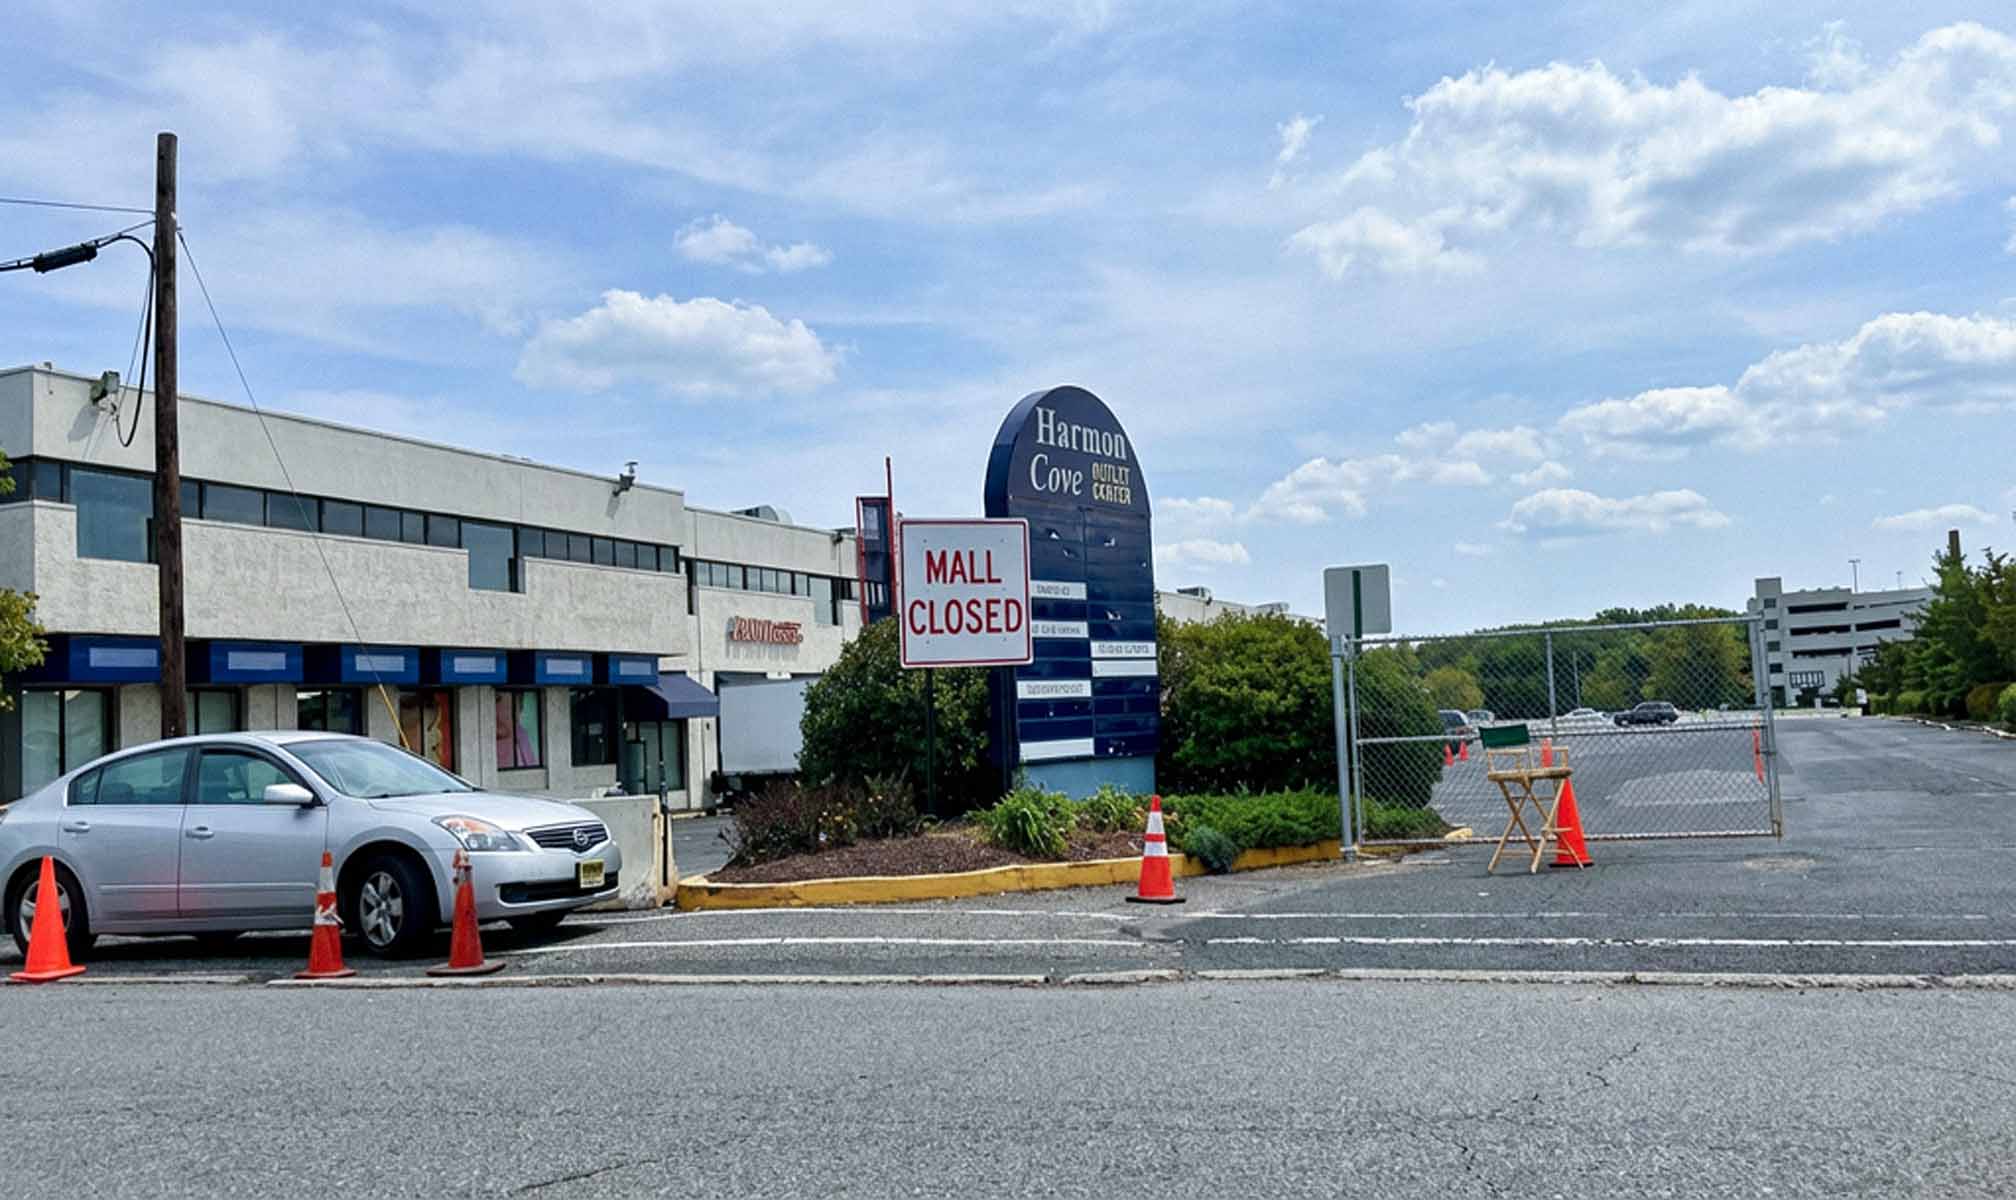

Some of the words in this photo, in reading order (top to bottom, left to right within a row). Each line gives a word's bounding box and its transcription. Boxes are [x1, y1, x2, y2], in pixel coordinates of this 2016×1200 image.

[1035, 406, 1127, 460] Harmon
[1030, 453, 1083, 495] Cove
[1092, 462, 1130, 485] OUTLET
[1092, 482, 1132, 505] CENTER
[926, 550, 1002, 584] MALL
[908, 599, 1022, 635] CLOSED
